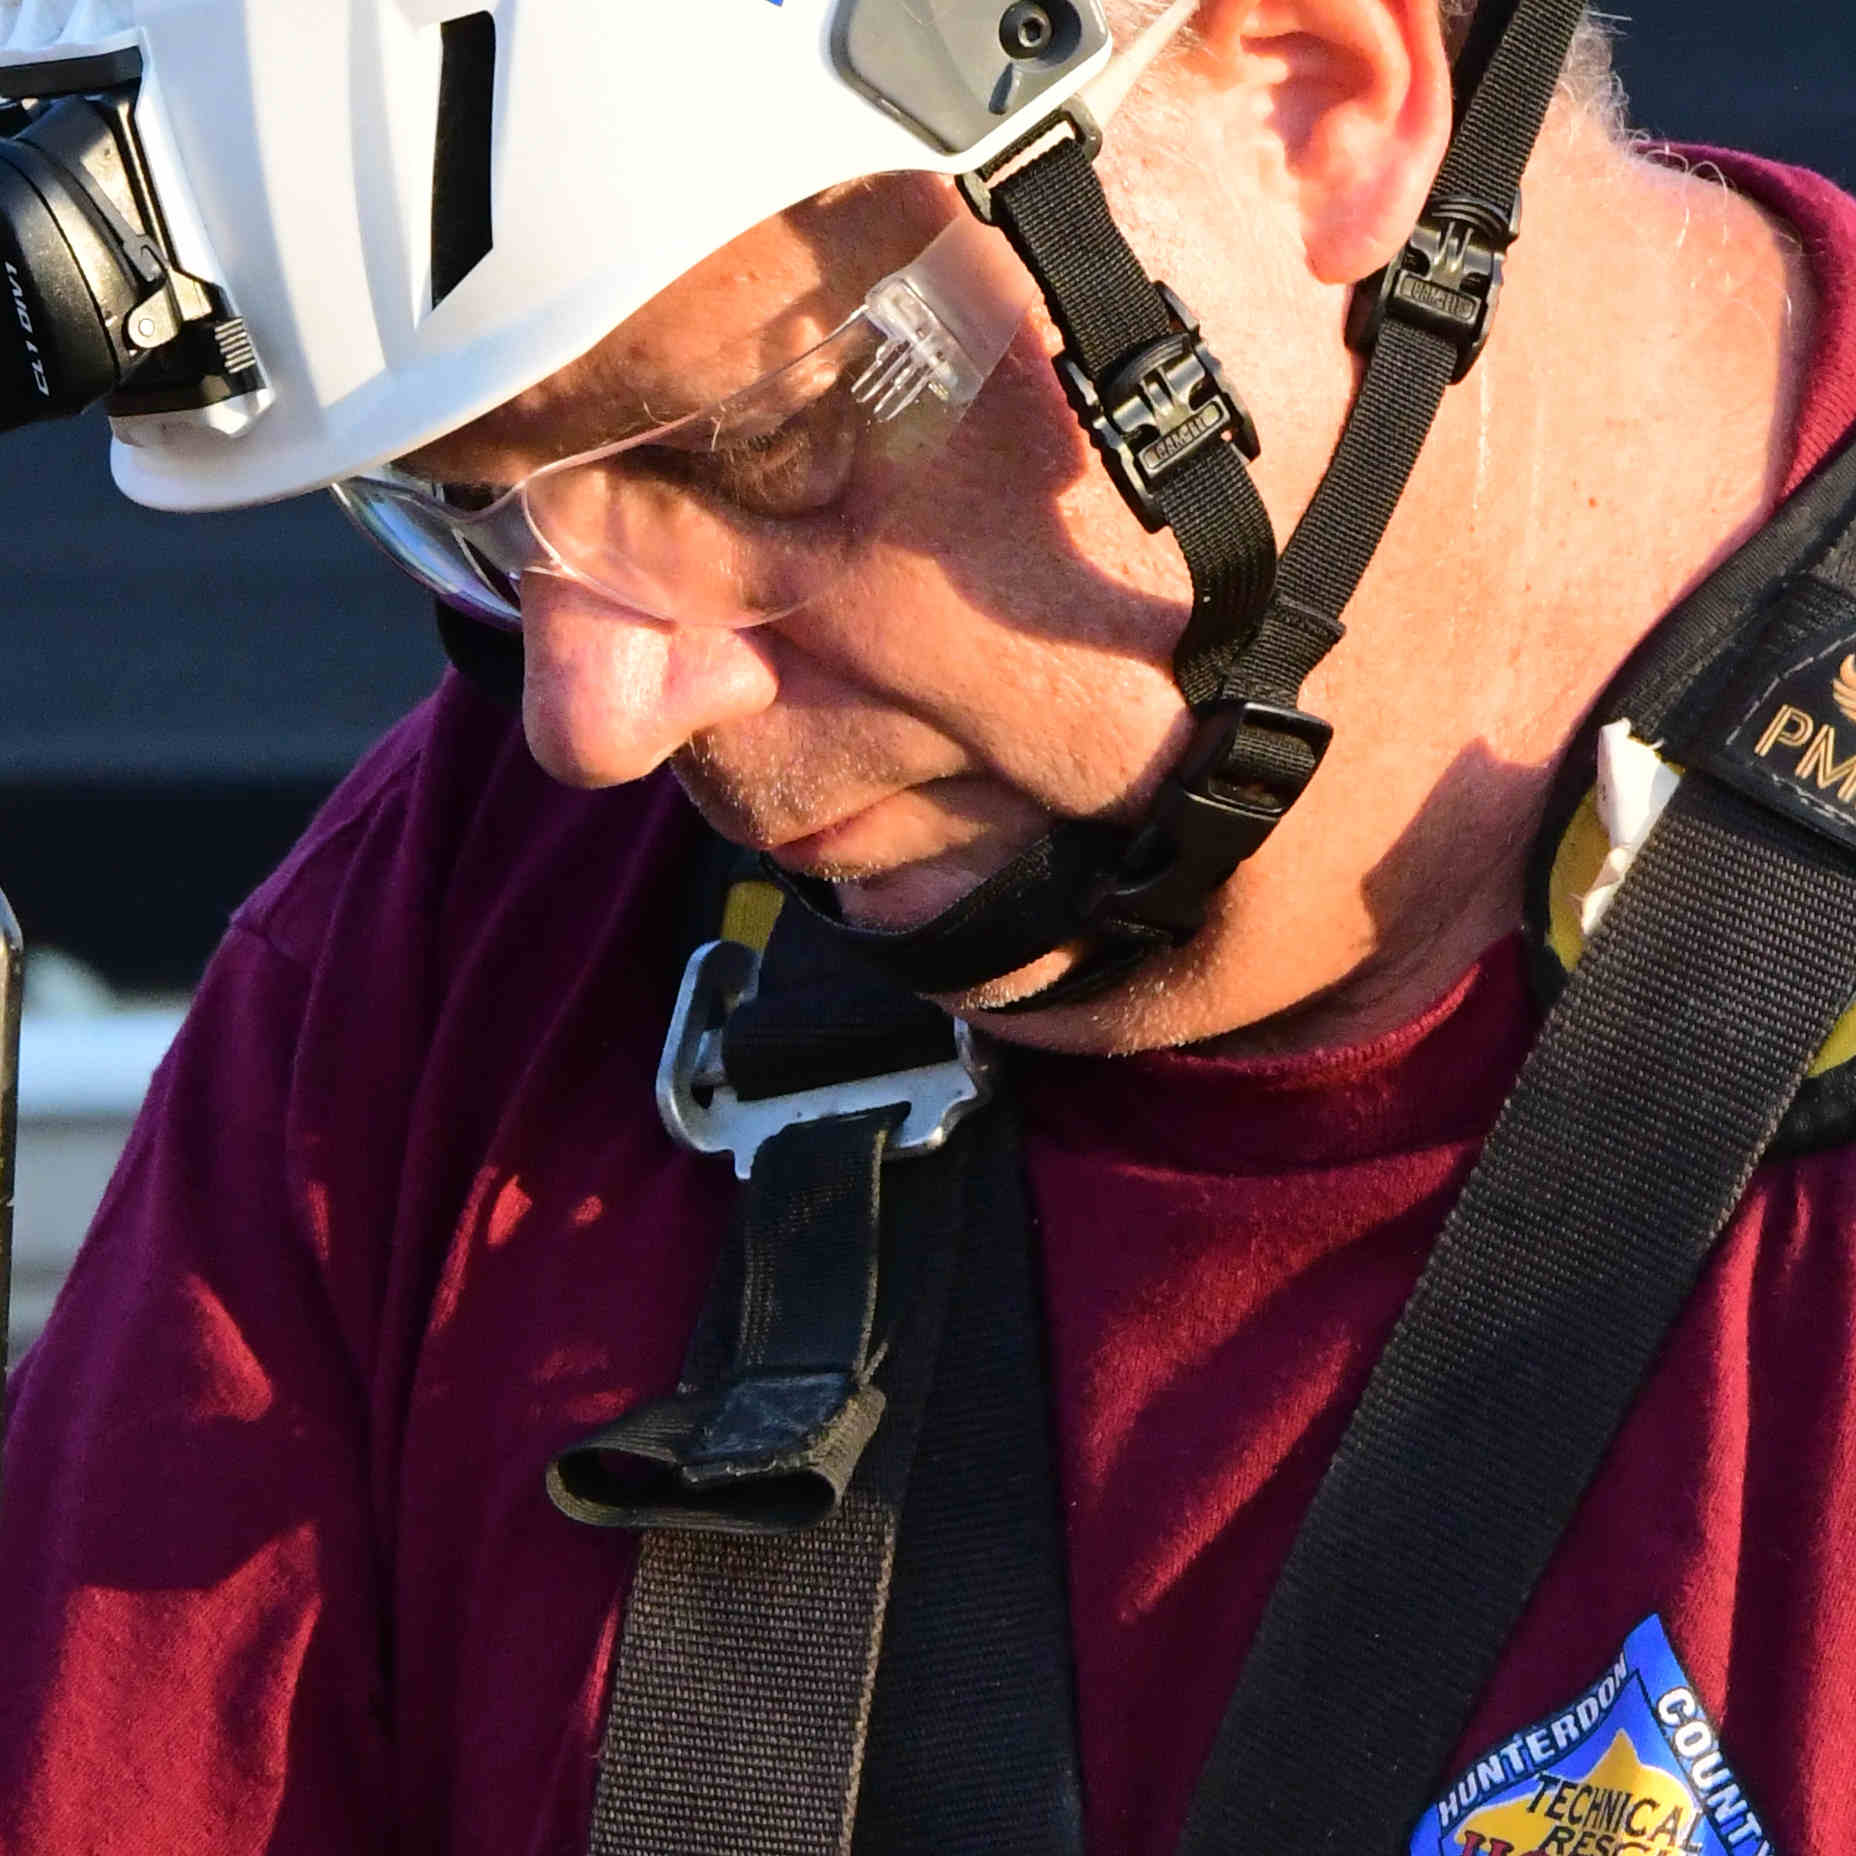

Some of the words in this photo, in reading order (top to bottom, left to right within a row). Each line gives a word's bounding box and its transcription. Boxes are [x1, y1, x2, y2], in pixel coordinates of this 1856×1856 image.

[7, 276, 34, 334] DIV
[1438, 1652, 1628, 1827] HUNTERDON
[1525, 1772, 1703, 1856] TECHNICAL
